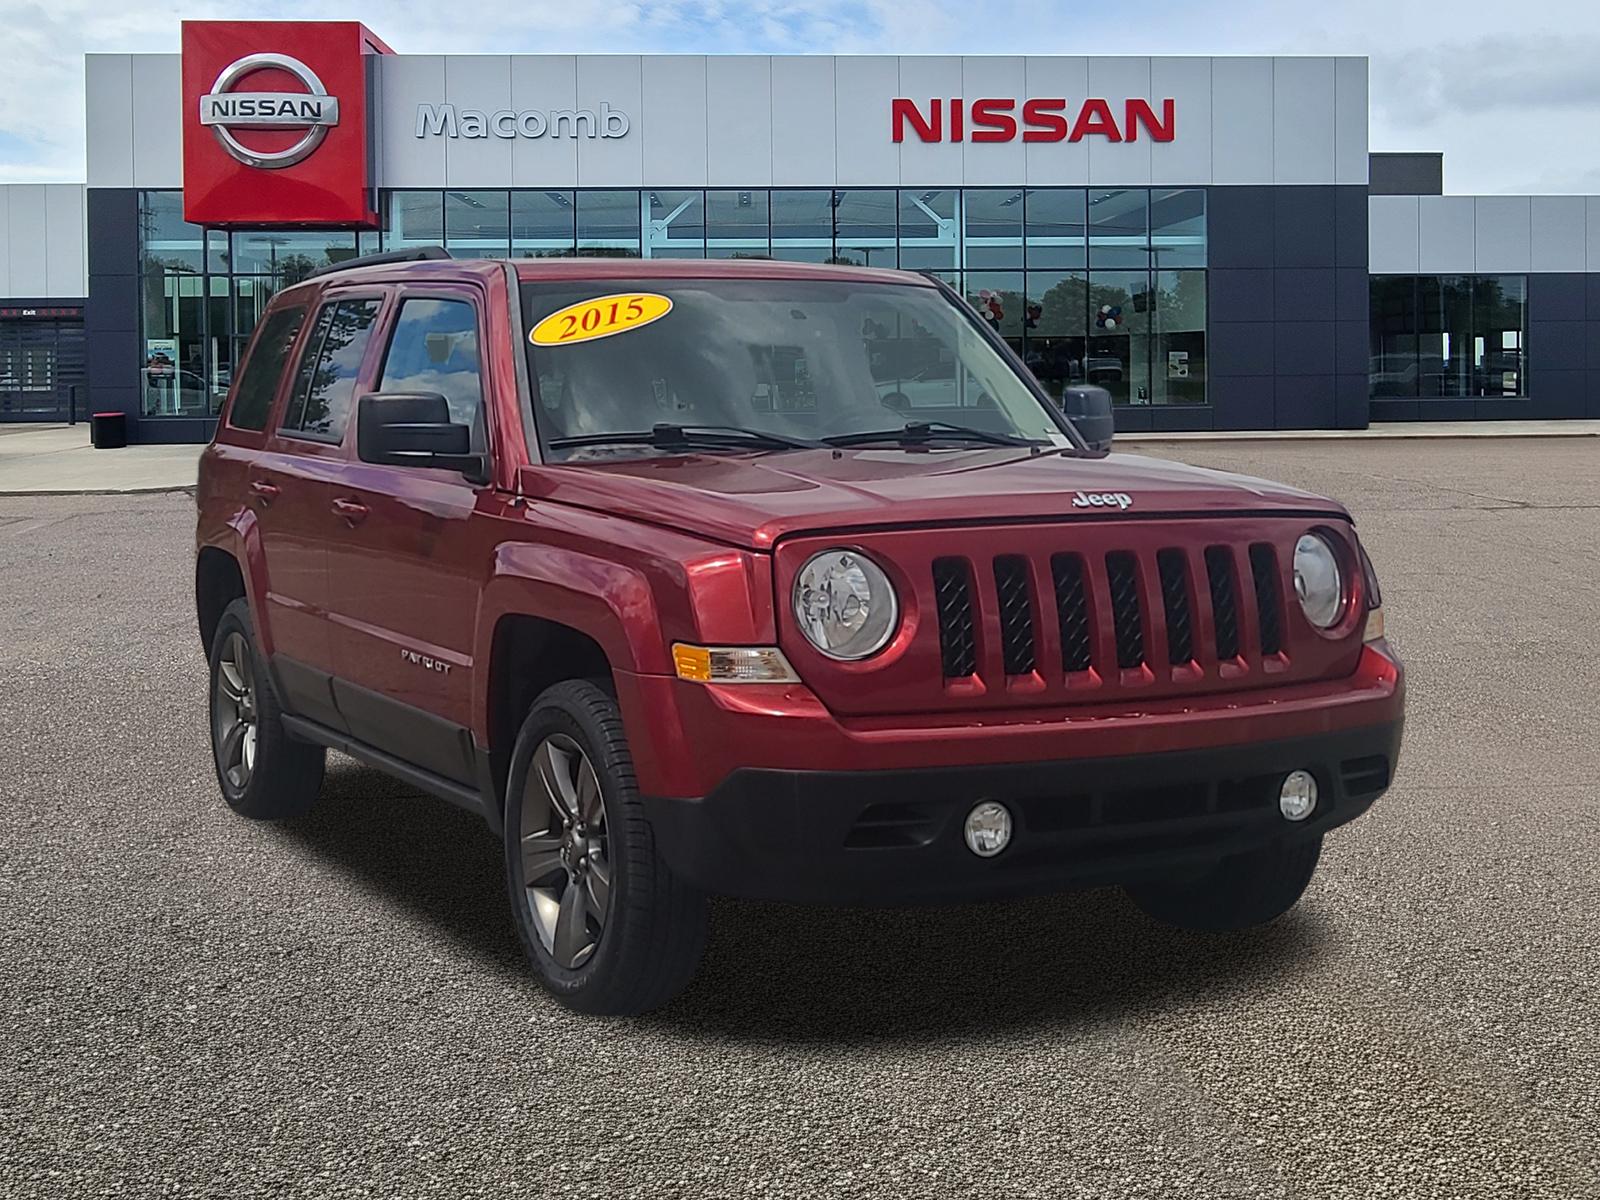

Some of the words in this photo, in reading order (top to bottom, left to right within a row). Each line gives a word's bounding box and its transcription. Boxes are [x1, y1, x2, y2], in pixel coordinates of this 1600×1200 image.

[212, 100, 322, 118] NISSAN
[415, 102, 630, 138] Macomb
[892, 98, 1175, 143] NISSAN
[559, 297, 644, 340] 2015
[1072, 490, 1133, 510] Jeep
[401, 649, 451, 674] PATRIOT
